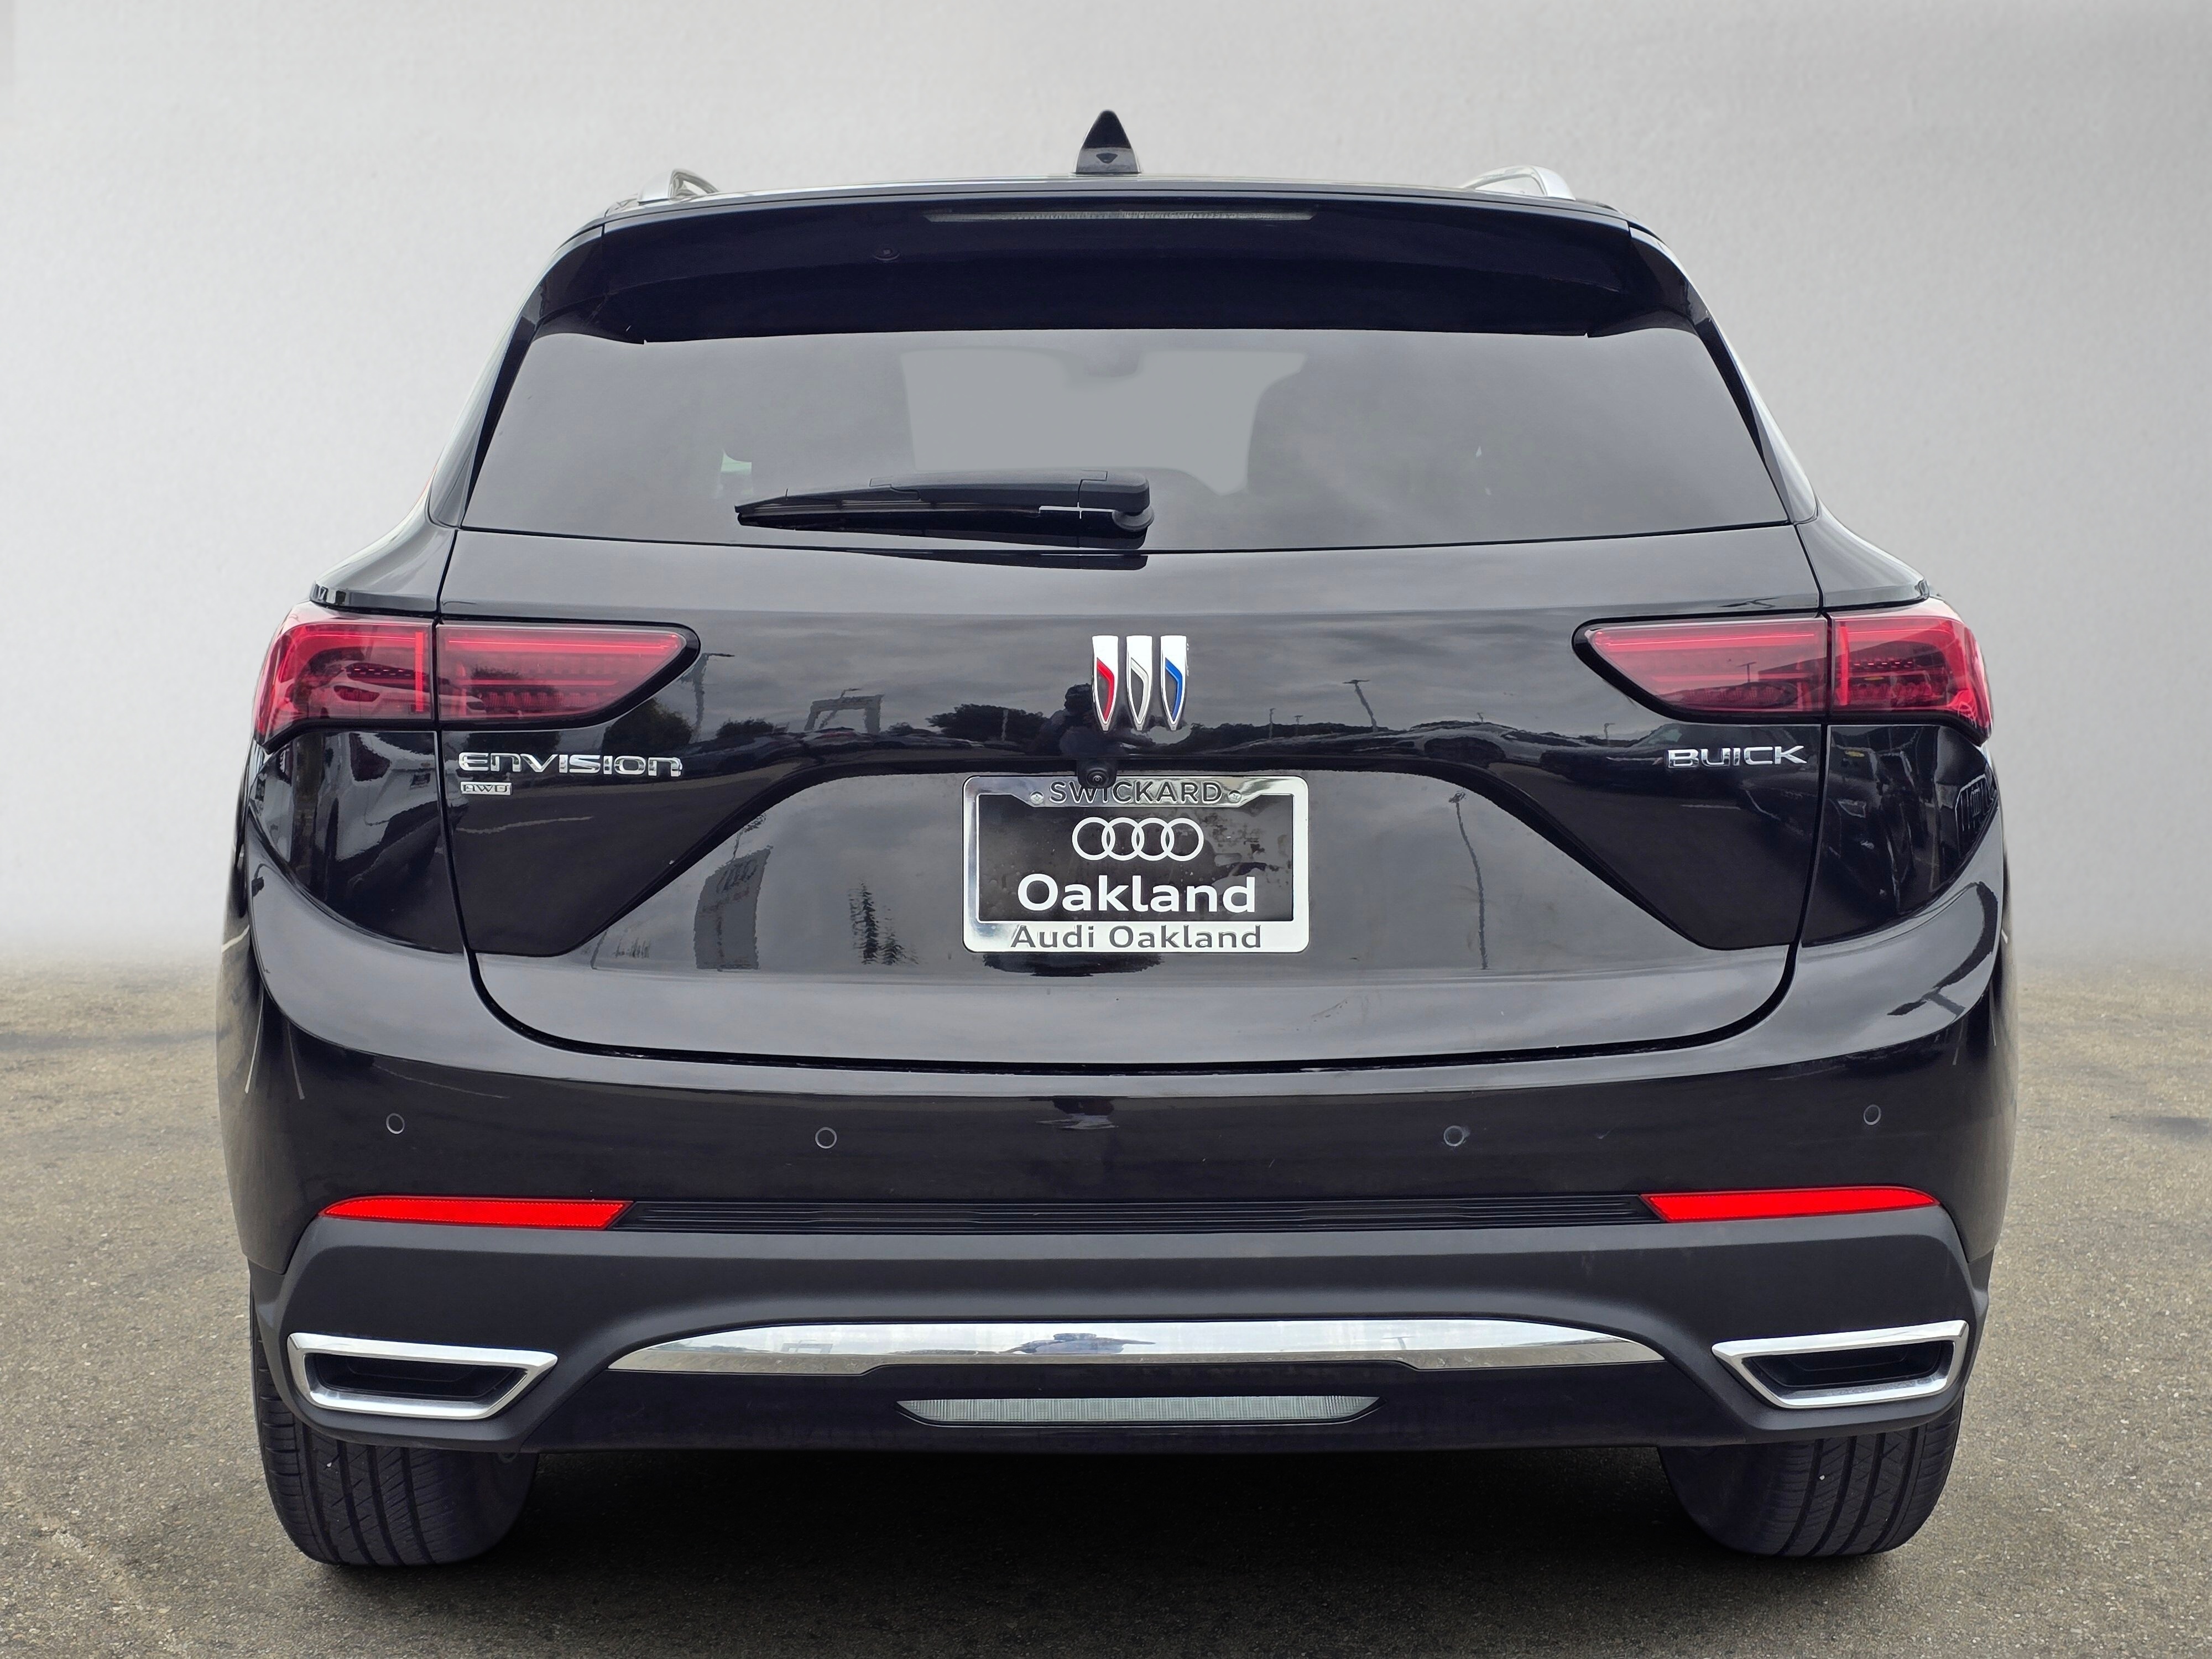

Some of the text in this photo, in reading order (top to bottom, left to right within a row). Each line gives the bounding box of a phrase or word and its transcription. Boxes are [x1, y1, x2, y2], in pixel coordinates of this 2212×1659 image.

[458, 752, 683, 778] ENVISION
[1667, 745, 1807, 768] BUICK
[462, 784, 509, 794] AWD
[1050, 780, 1223, 804] SWICKARD
[1018, 873, 1256, 914] Oakland
[1011, 925, 1261, 949] Audi Oakland
